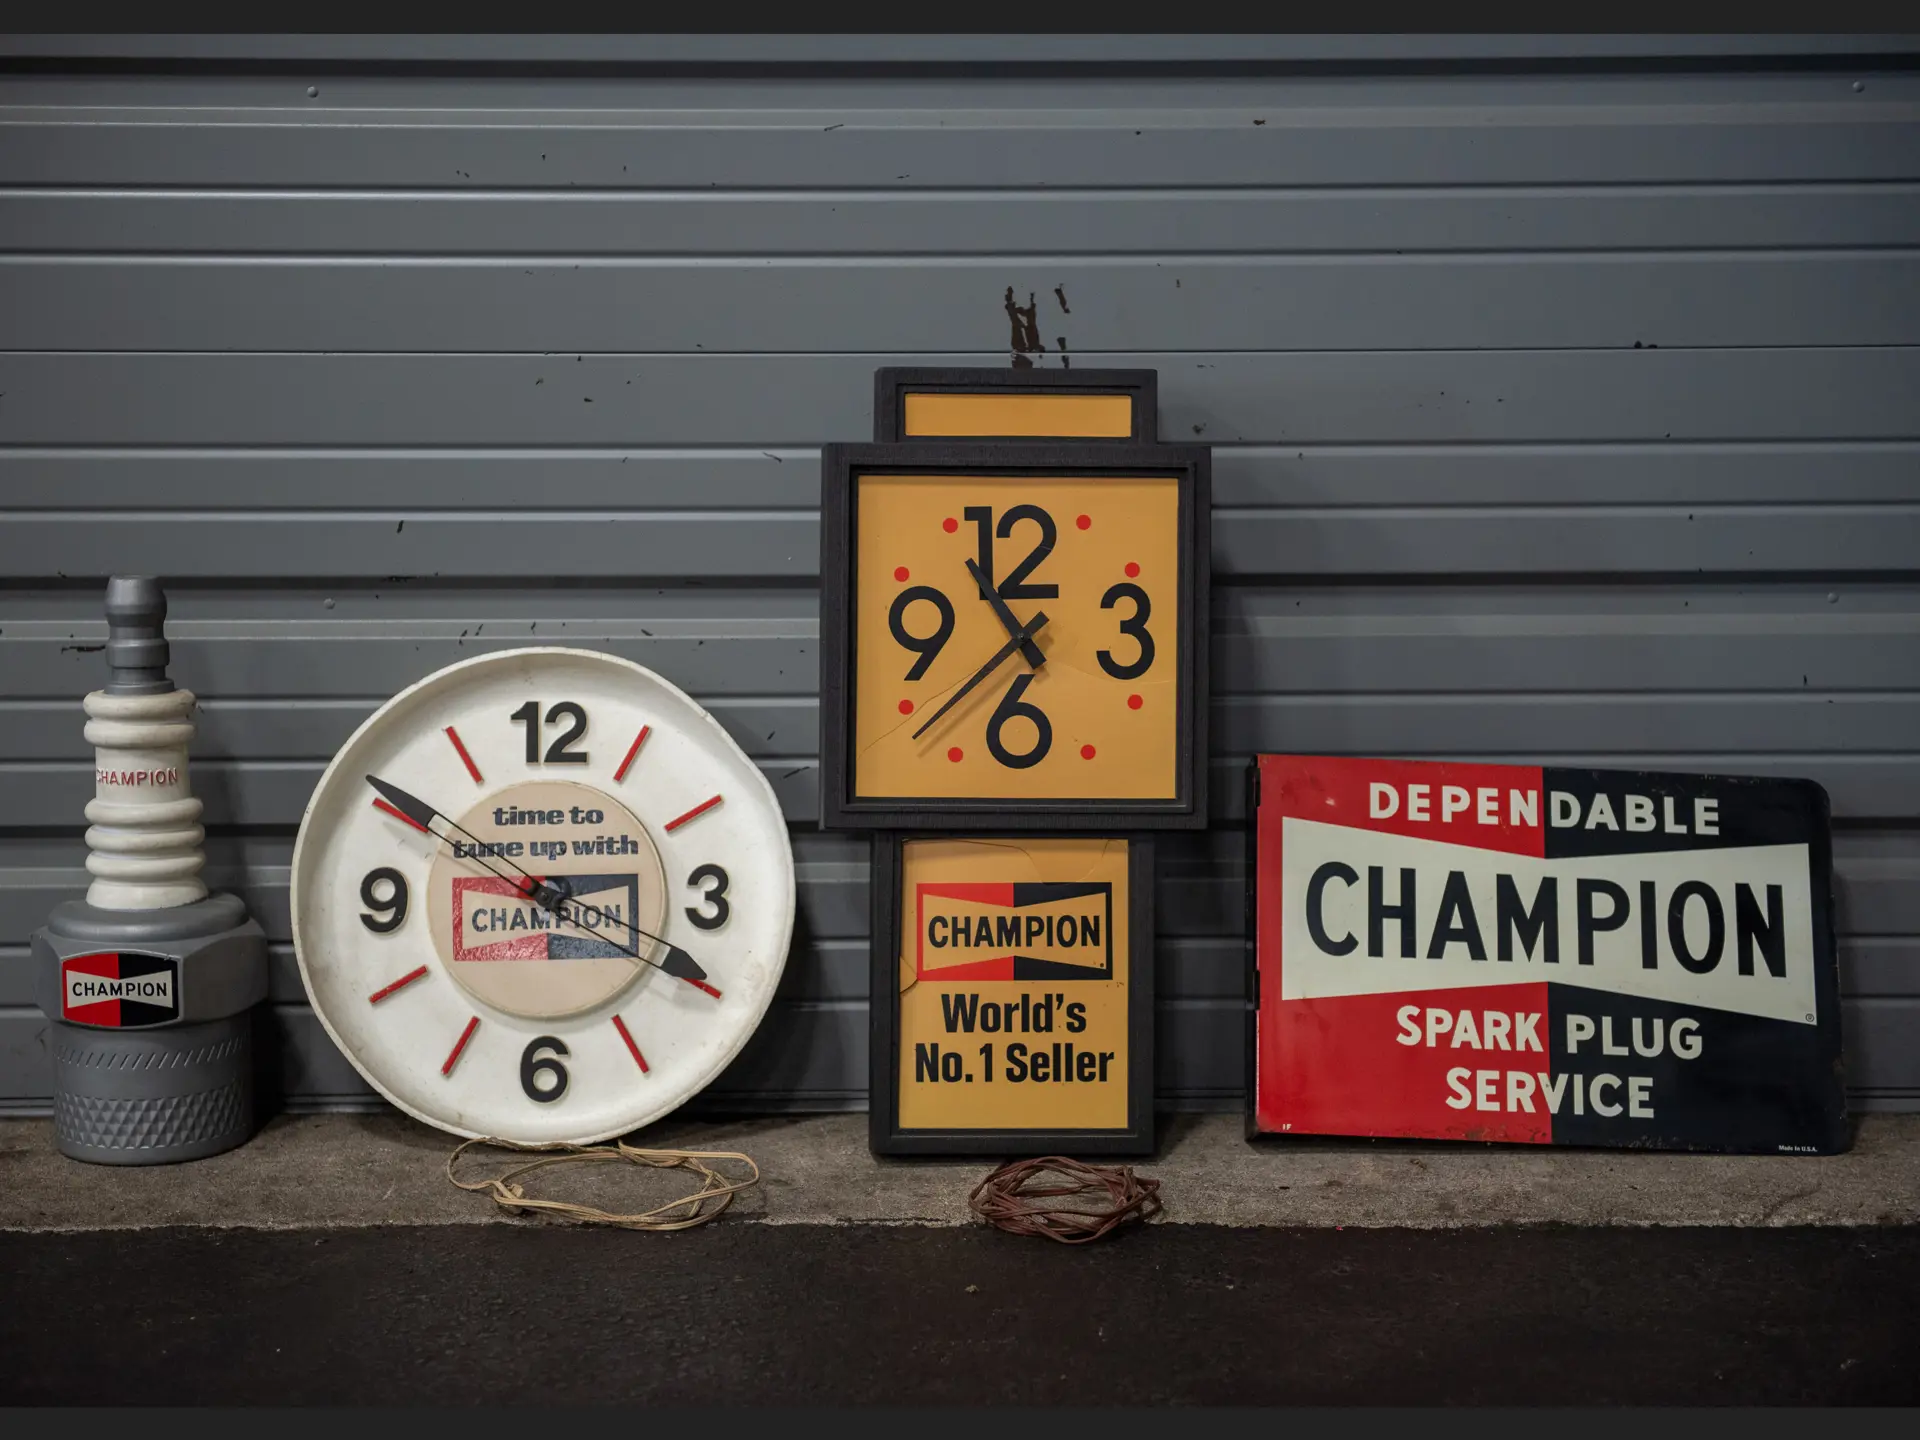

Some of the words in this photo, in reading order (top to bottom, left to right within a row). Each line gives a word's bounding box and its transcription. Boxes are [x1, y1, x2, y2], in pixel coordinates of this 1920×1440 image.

[964, 504, 1059, 600] 12
[888, 585, 955, 681] 9
[1096, 582, 1155, 680] 3
[510, 701, 589, 764] 12
[986, 673, 1052, 769] 6
[493, 806, 565, 826] time
[569, 806, 604, 825] to
[1369, 782, 1720, 836] DEPENDABLE
[453, 839, 524, 859] tune
[529, 840, 568, 861] up
[571, 834, 639, 856] with
[359, 867, 408, 933] 9
[471, 904, 622, 932] CHAMPION
[685, 864, 730, 930] 3
[1305, 861, 1787, 979] CHAMPION
[928, 915, 1101, 948] CHAMPION
[72, 982, 168, 997] CHAMPION
[941, 993, 1087, 1034] World's
[1396, 1005, 1544, 1053] SPARK
[1566, 1015, 1703, 1060] PLUG
[520, 1036, 569, 1102] 6
[1005, 1042, 1115, 1083] Seller
[1445, 1067, 1655, 1119] SERVICE
